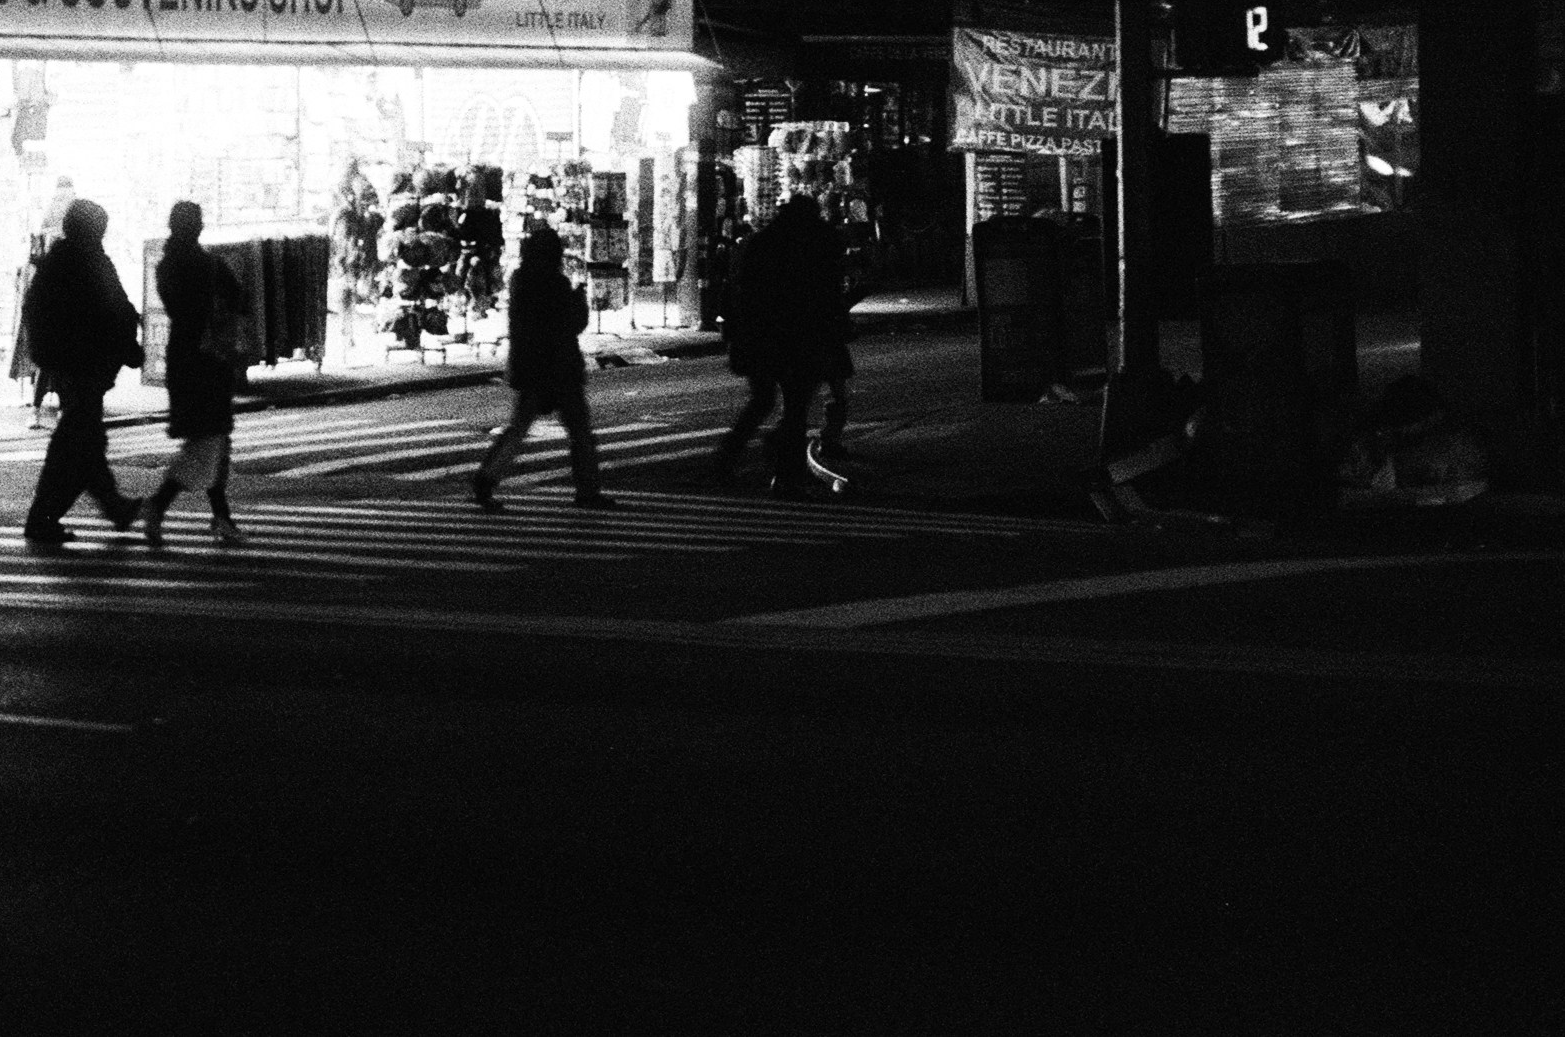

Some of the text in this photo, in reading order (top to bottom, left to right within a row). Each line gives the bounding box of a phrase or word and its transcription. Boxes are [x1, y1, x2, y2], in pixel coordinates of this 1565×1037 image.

[516, 11, 606, 30] LITTLE ITALY
[981, 35, 1116, 60] RESTAURANT
[1010, 132, 1057, 152] PIZZA
